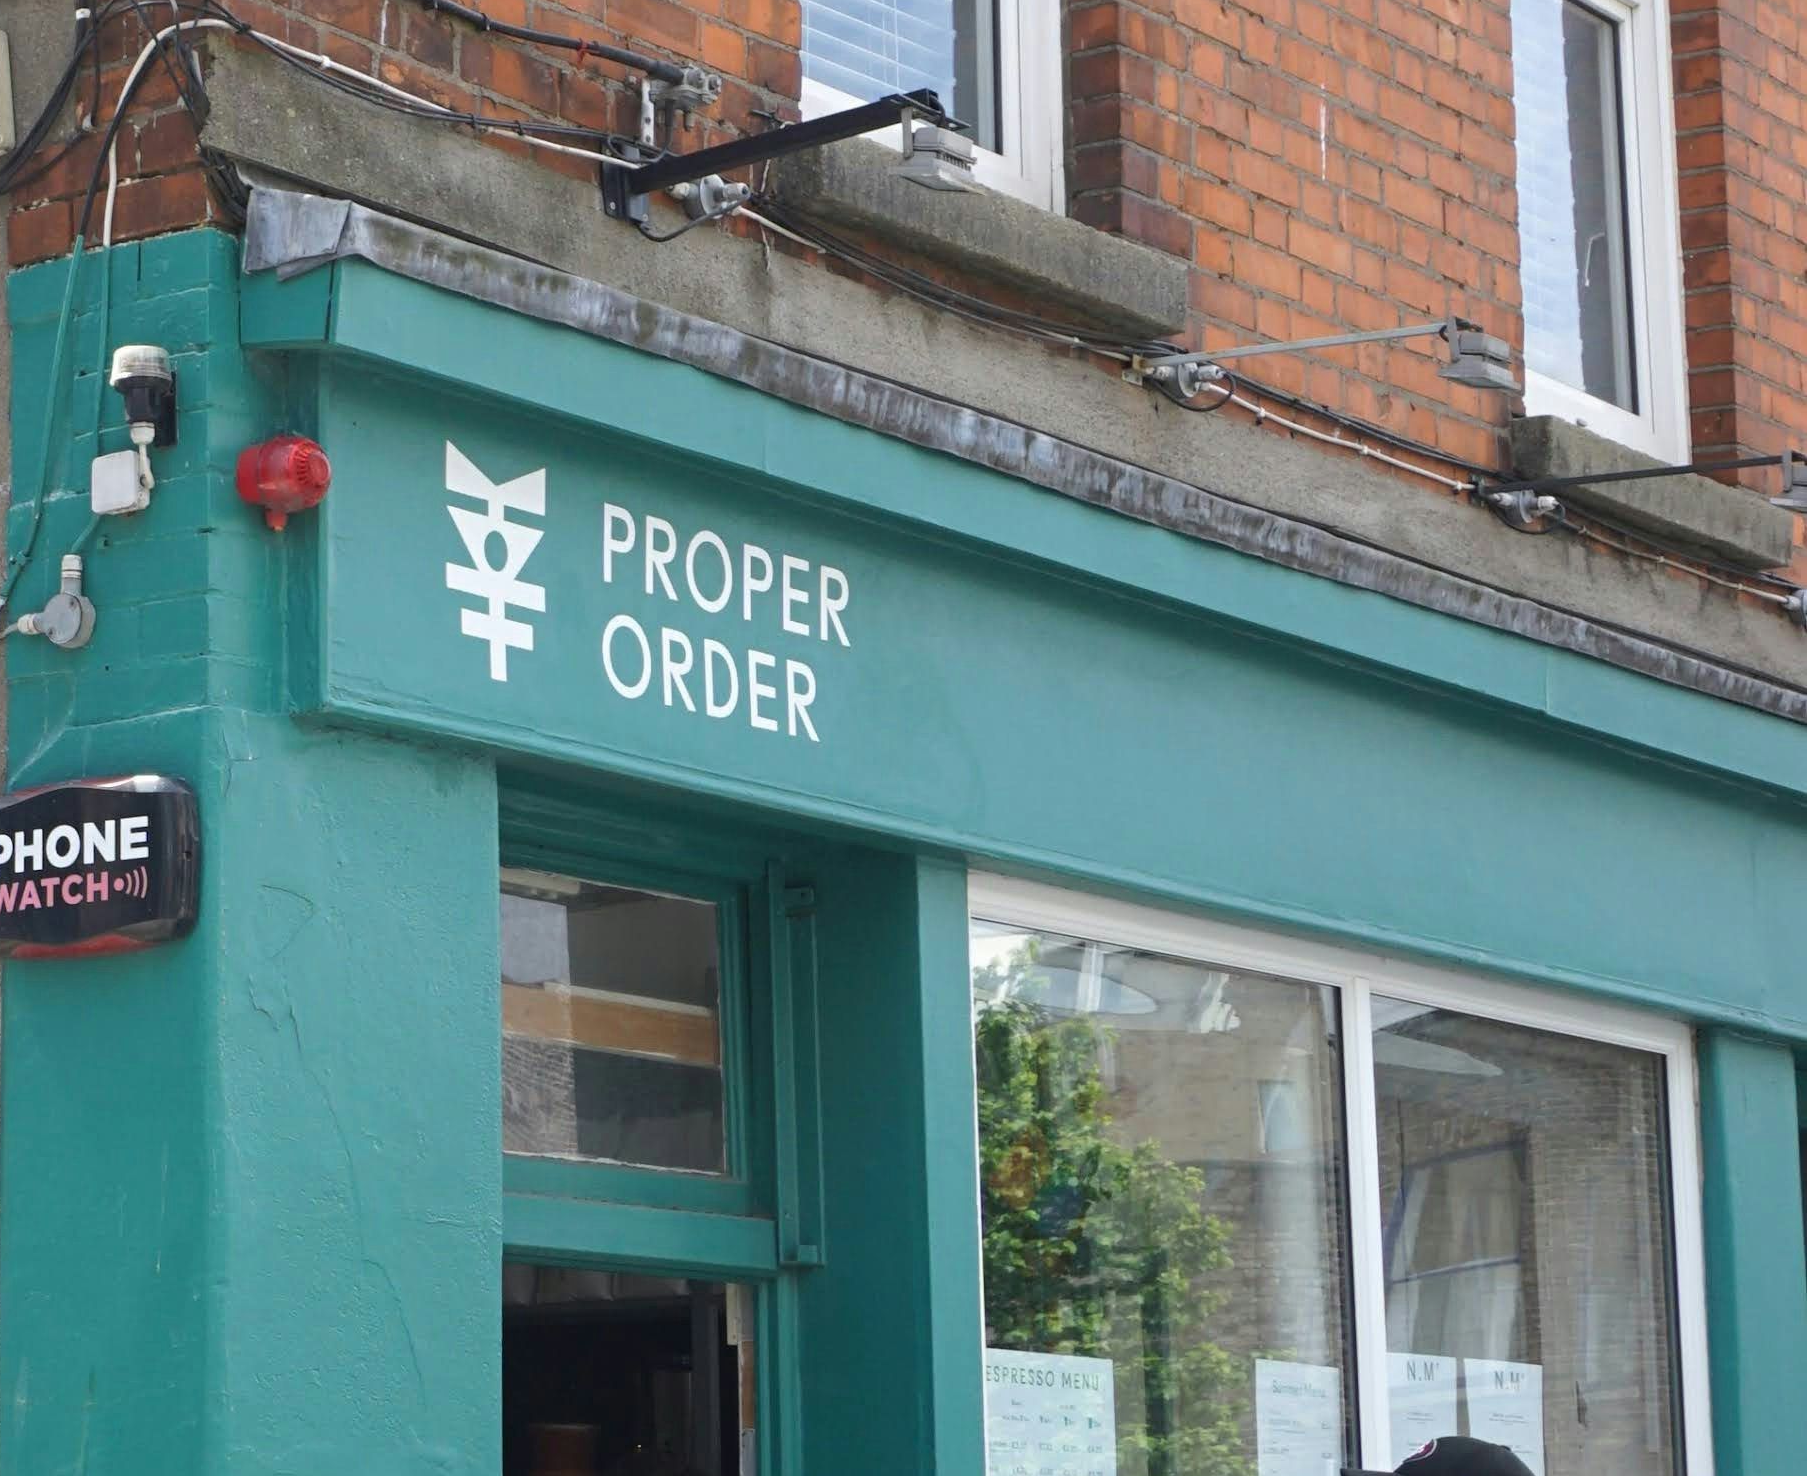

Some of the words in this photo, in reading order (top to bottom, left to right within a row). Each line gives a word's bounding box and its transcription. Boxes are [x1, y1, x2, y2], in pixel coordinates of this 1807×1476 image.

[603, 502, 850, 647] PROPER
[602, 614, 820, 742] ORDER
[985, 1365, 1055, 1387] ESPRESSO
[1061, 1372, 1099, 1391] MENU
